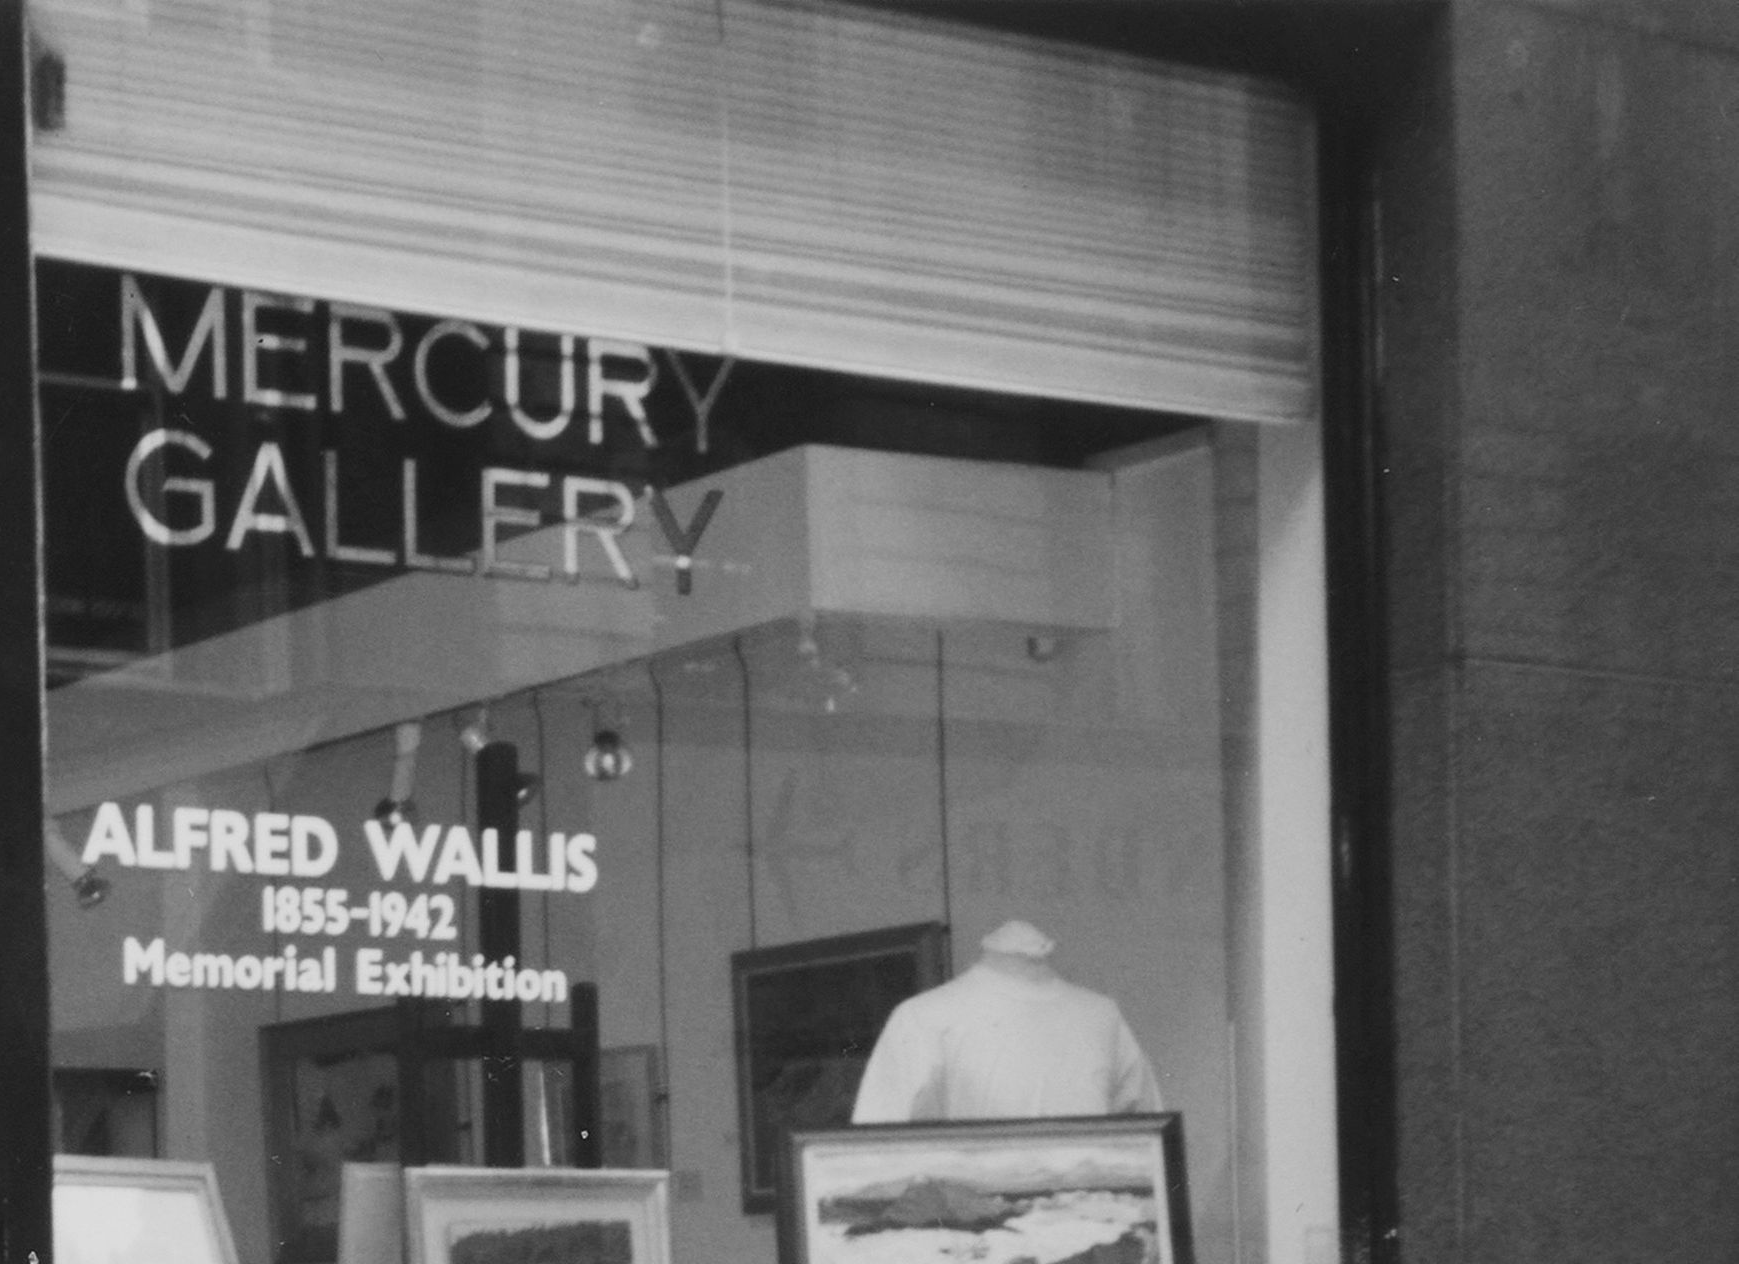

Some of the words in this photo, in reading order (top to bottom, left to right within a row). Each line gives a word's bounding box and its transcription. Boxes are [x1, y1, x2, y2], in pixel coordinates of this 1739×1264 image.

[120, 274, 736, 454] MERCURY
[124, 427, 725, 595] GALLERY
[81, 801, 338, 878] ALFRED
[363, 818, 599, 893] WALLIS
[262, 885, 458, 940] 1855-1942
[122, 936, 337, 993] Memorial
[355, 947, 568, 1003] Exhibition
